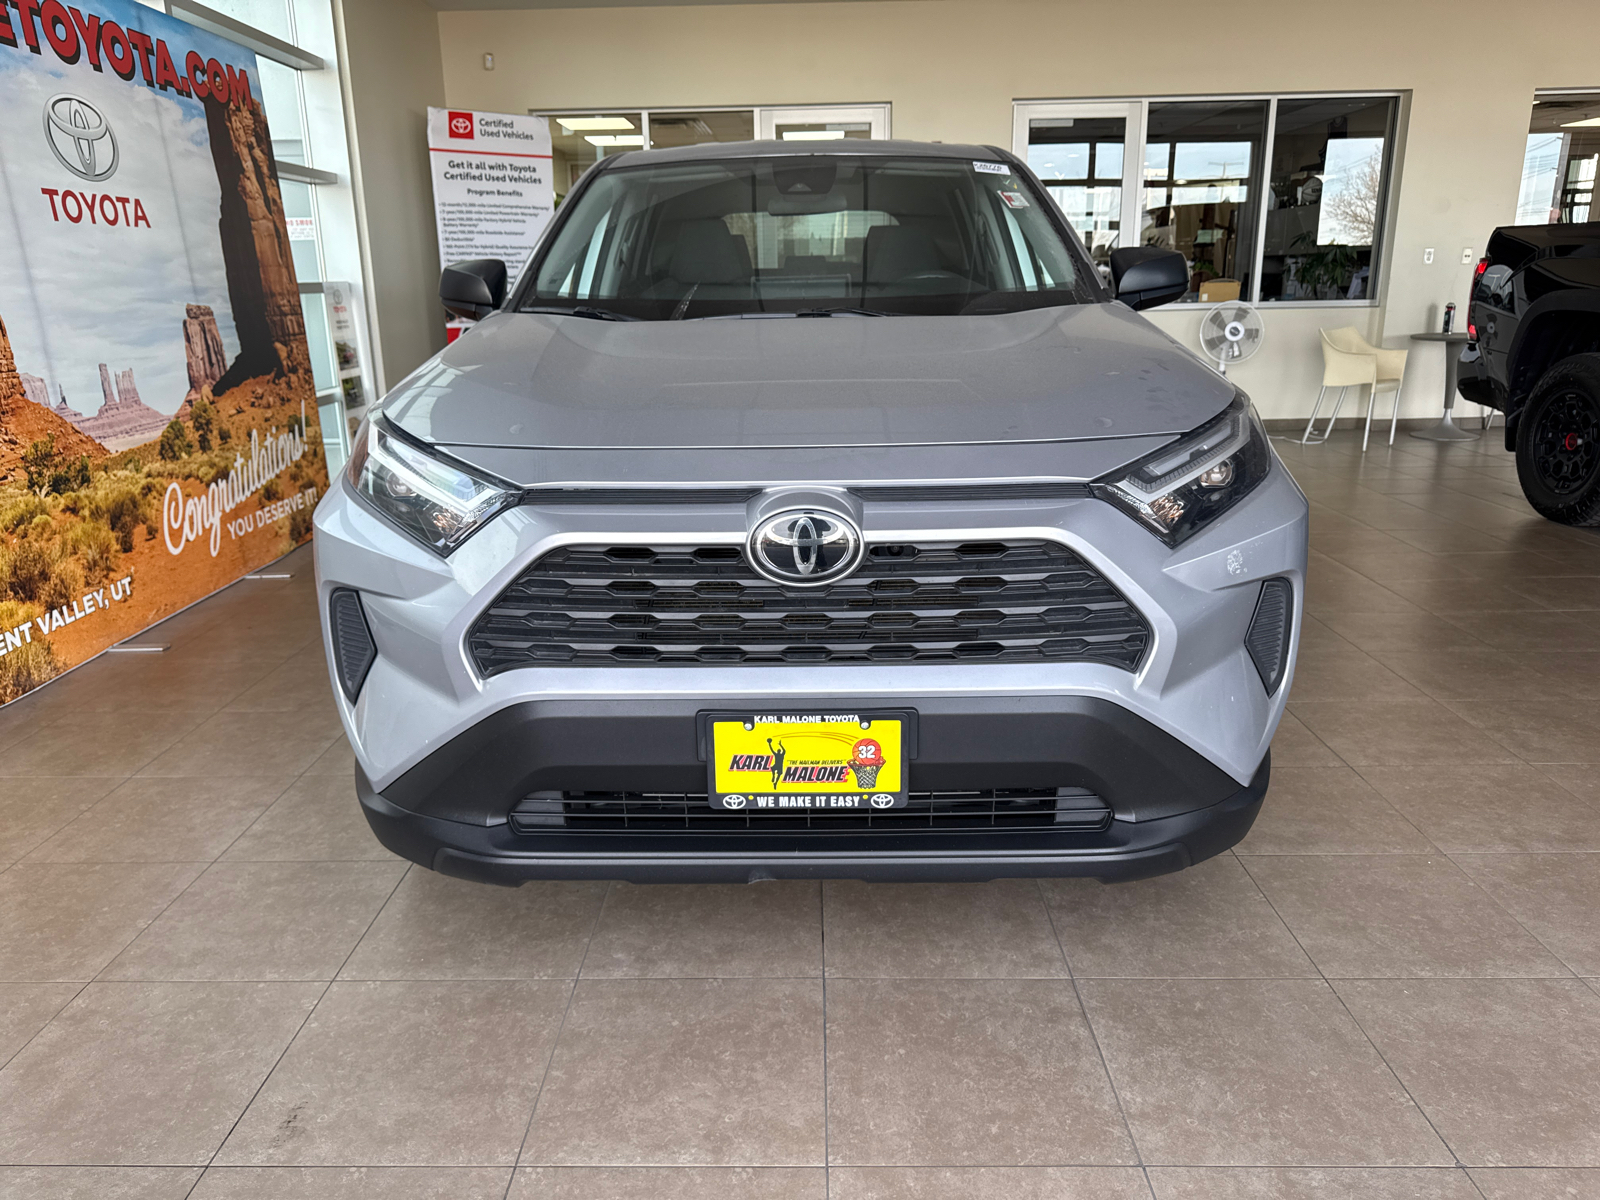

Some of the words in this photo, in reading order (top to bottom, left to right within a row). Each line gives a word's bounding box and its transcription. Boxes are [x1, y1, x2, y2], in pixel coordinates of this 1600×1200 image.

[479, 118, 514, 129] Certified
[480, 129, 500, 138] Used
[501, 131, 534, 141] Vehicles
[448, 160, 465, 170] Get
[466, 161, 474, 170] it
[475, 161, 487, 171] all
[488, 162, 508, 172] with
[508, 163, 537, 174] Toyota
[444, 171, 483, 181] Certified
[484, 173, 506, 183] Used
[507, 174, 542, 184] Vehicles
[467, 188, 496, 197] Program
[497, 189, 523, 197] Benefits
[41, 187, 152, 229] TOYOTA
[163, 399, 308, 557] Congratulations!
[227, 514, 254, 540] YOU
[255, 494, 303, 528] DESERVE
[304, 486, 318, 507] IT!
[36, 588, 110, 635] VALLEY,
[110, 576, 131, 602] UT
[754, 716, 778, 724] KARL
[782, 715, 822, 724] MALONE
[823, 714, 860, 723] TOYOTA
[858, 745, 876, 759] 32
[728, 754, 773, 772] KARL
[781, 766, 850, 783] MALONE
[757, 796, 775, 807] WE
[779, 796, 812, 807] MAKE
[815, 796, 827, 807] IT
[830, 795, 861, 807] EASY
